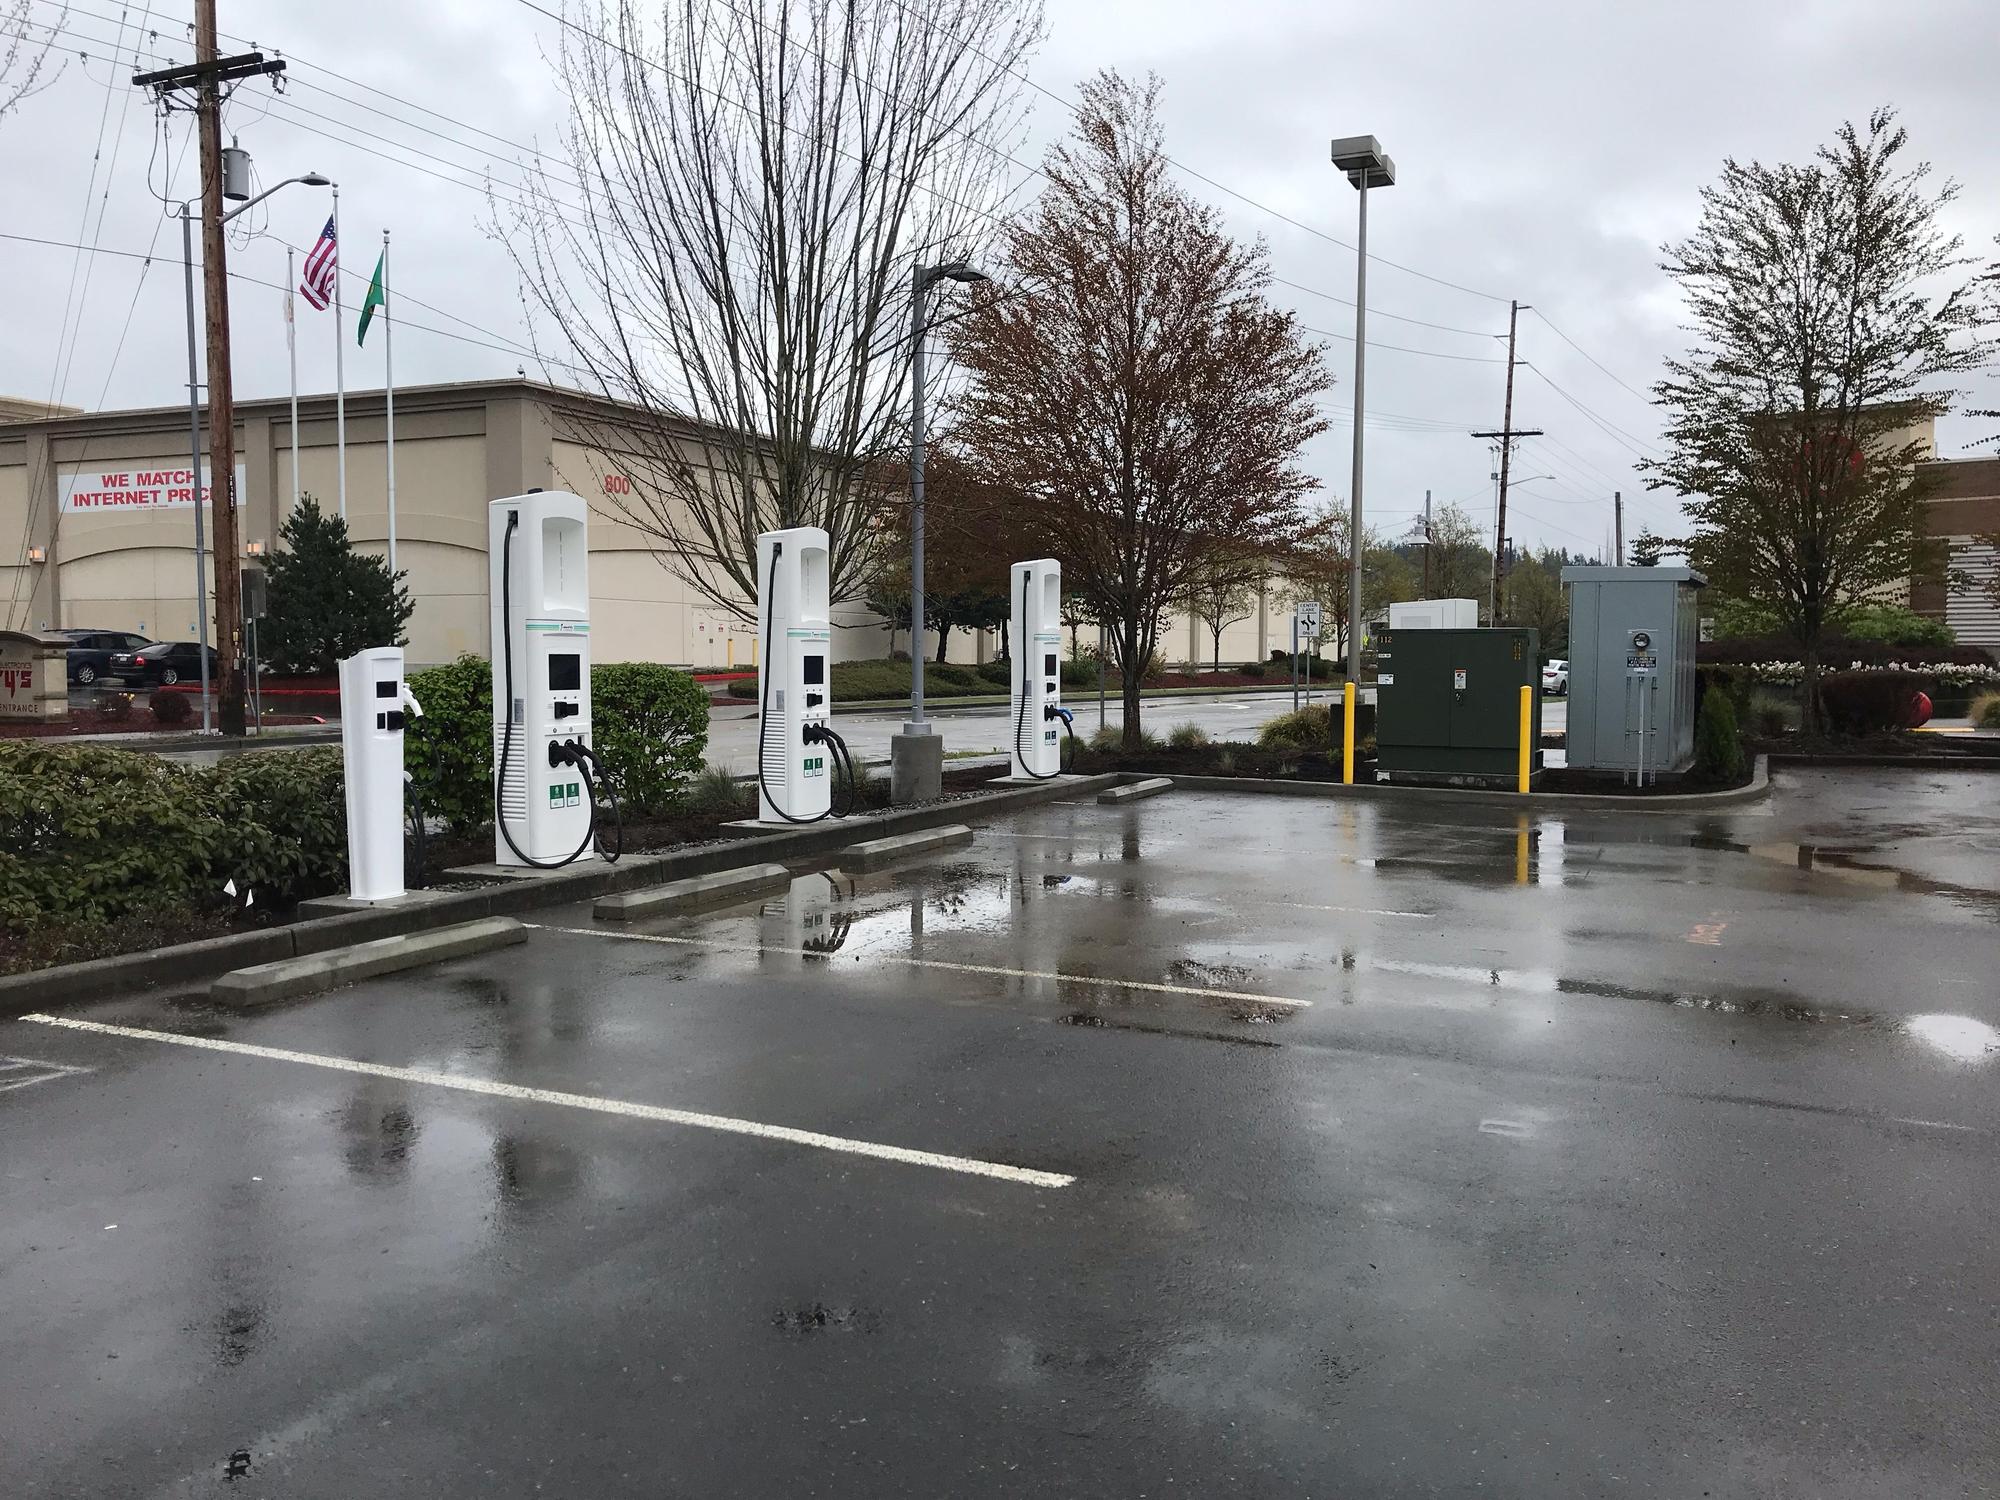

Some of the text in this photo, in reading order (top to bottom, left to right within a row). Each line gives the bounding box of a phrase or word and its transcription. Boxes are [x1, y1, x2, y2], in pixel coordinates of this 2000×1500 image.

[102, 473, 129, 488] WE
[605, 475, 630, 495] 800
[73, 490, 161, 507] INTERNET
